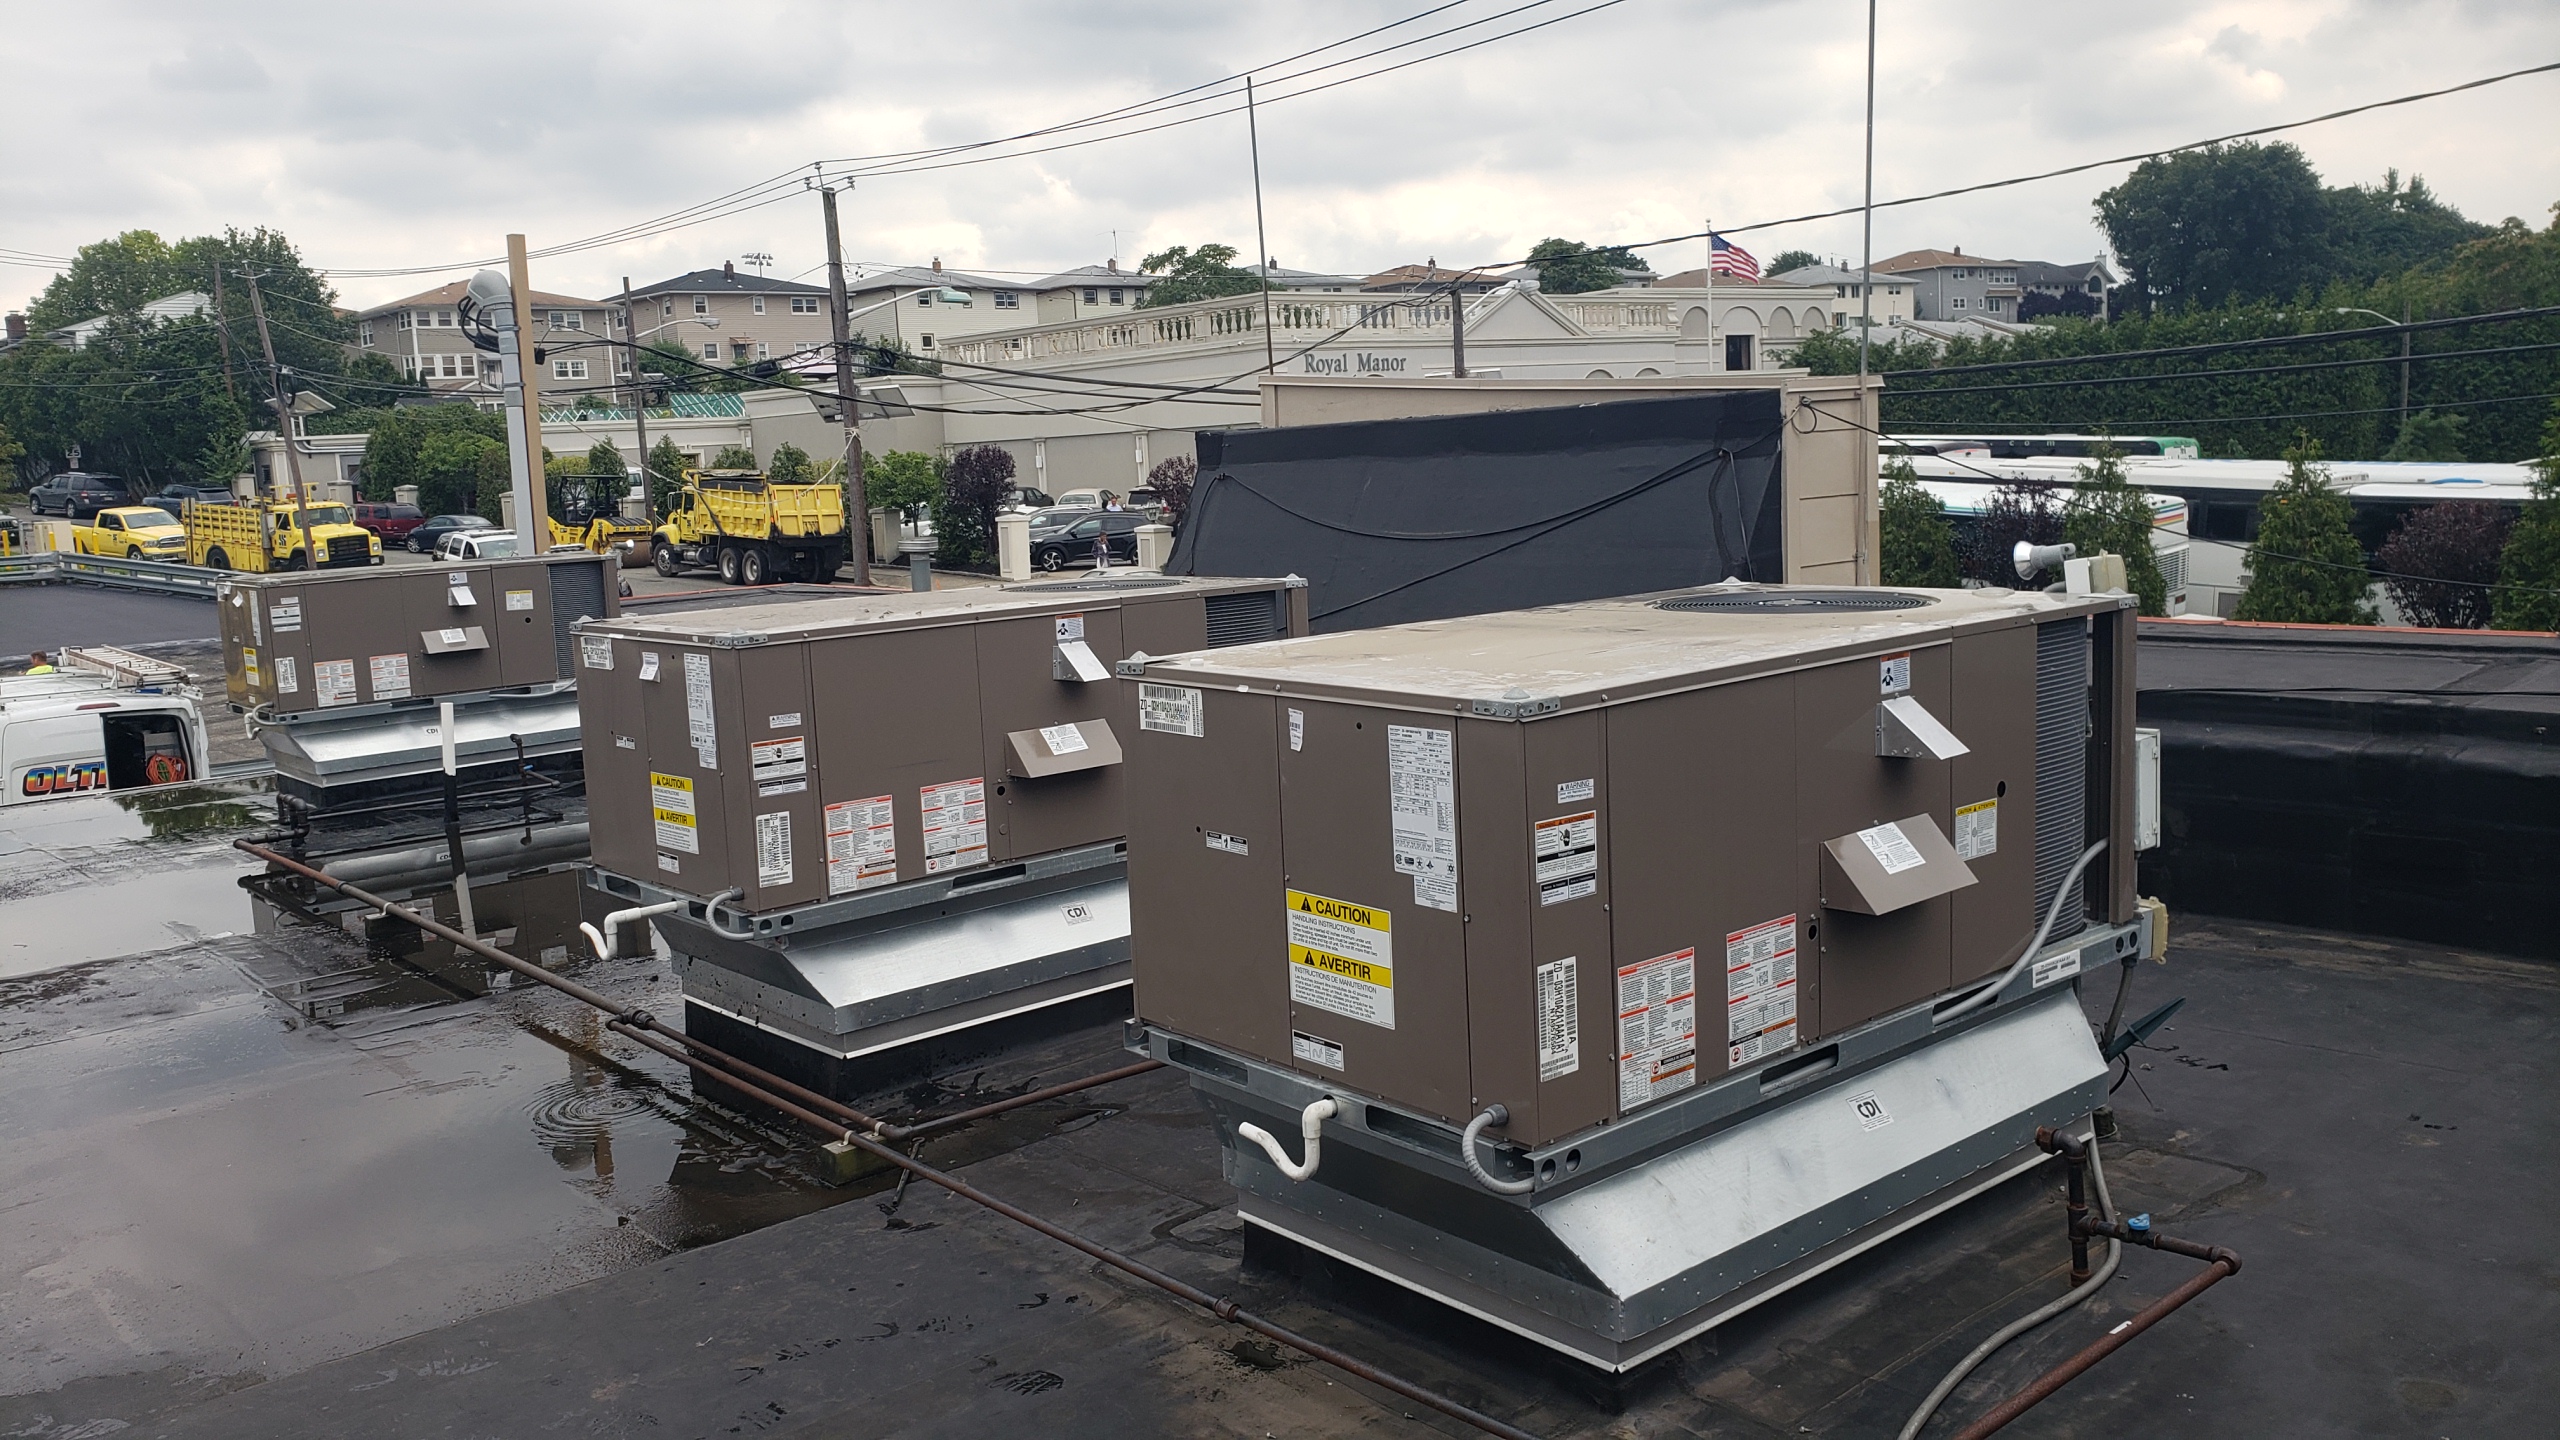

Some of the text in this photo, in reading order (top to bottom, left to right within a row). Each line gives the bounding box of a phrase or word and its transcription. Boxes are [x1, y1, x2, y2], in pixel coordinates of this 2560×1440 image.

[1304, 352, 1407, 376] Royal Manor
[661, 777, 685, 789] CAUTION
[1565, 779, 1590, 790] WARNING
[665, 812, 687, 825] AVERTIR
[1067, 906, 1087, 918] CDI
[1316, 900, 1371, 925] CAUTION
[1292, 912, 1355, 934] HANDLING INSTRUCTIONS
[1320, 955, 1371, 980] AVERTIR
[1294, 965, 1376, 994] INSTRUCTIONS DE MANUTENTION
[1857, 1099, 1882, 1118] CDI
